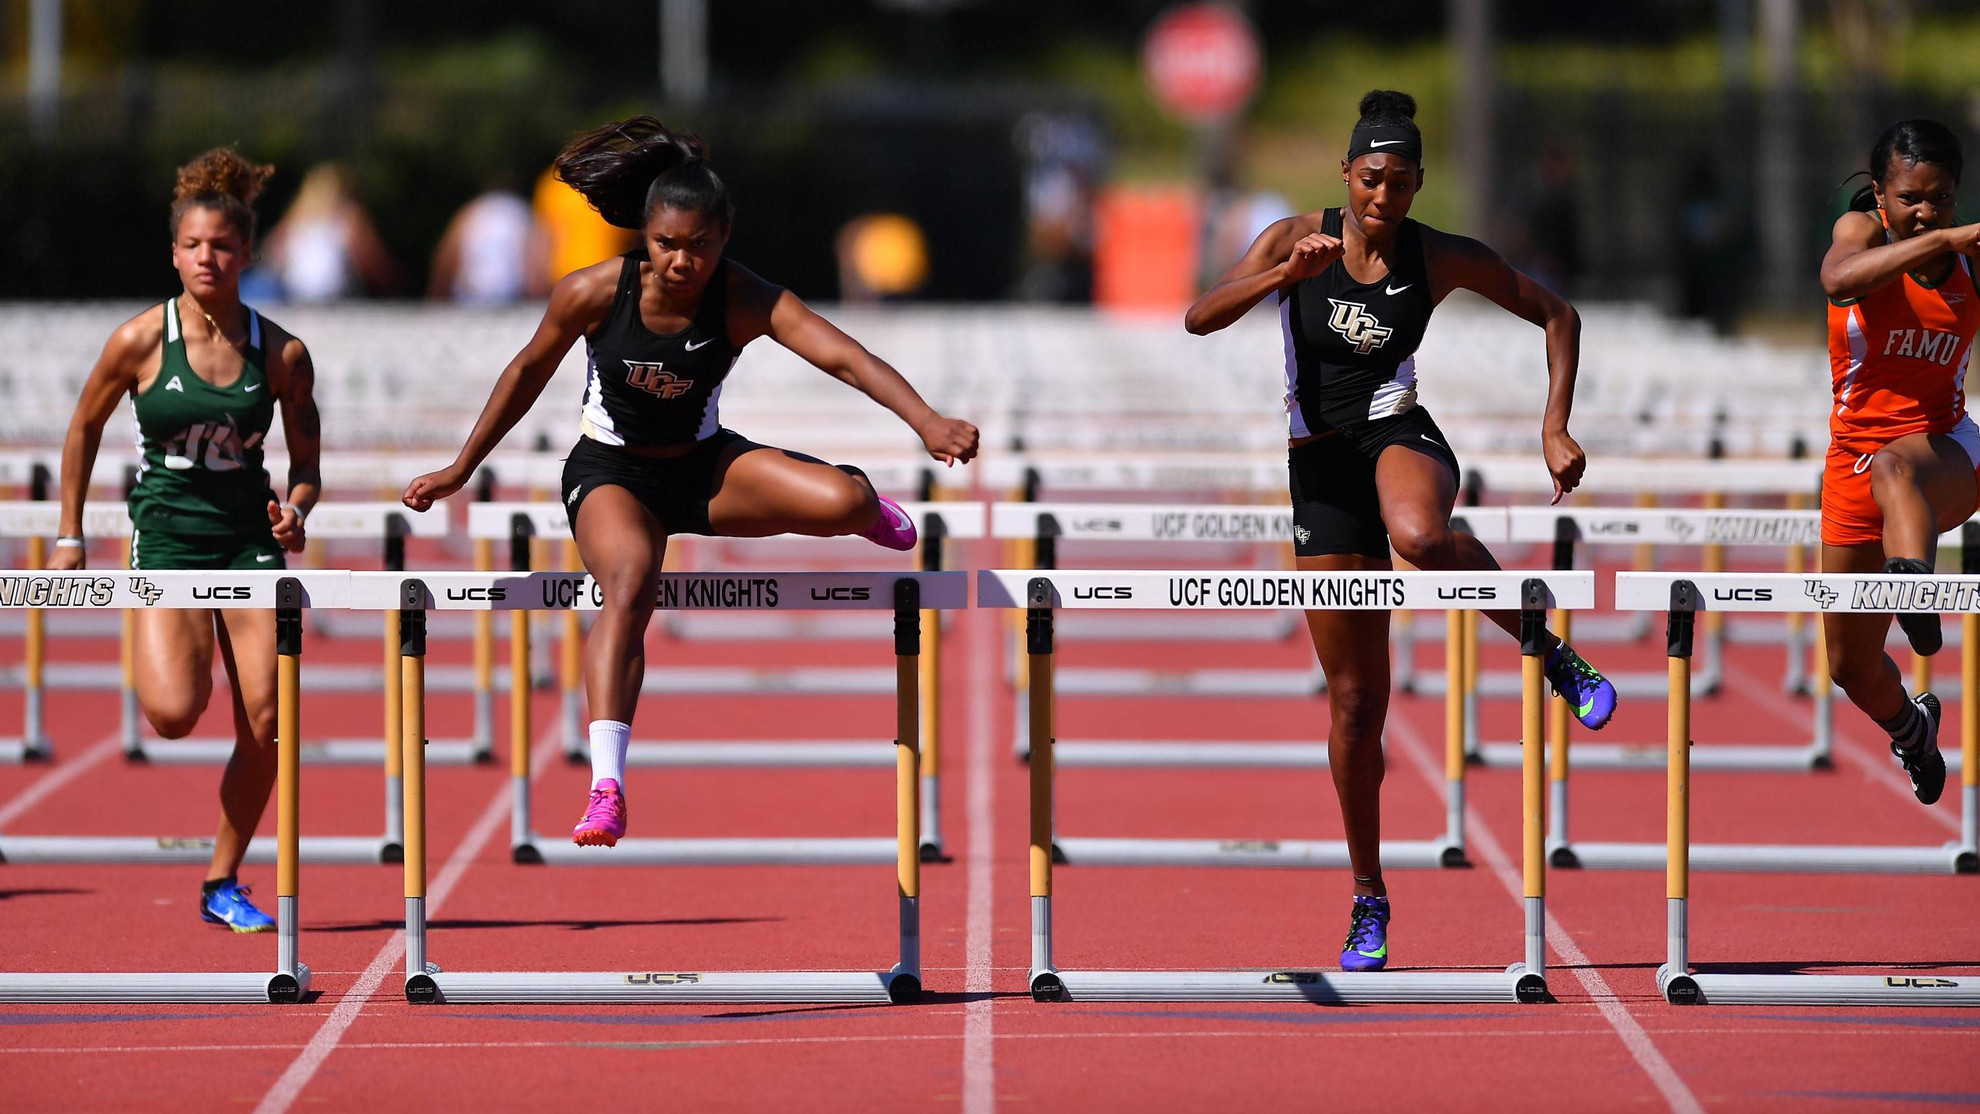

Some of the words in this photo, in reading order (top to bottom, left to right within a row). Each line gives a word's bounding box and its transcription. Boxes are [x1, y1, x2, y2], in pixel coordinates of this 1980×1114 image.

[1327, 298, 1393, 355] UCF
[1883, 329, 1960, 366] FAMU
[622, 360, 693, 399] UCF
[1152, 513, 1187, 538] UCF
[1193, 513, 1266, 538] GOLDEN
[1293, 524, 1311, 545] UCF
[129, 577, 164, 606] UCF
[193, 586, 251, 600] UCS
[447, 587, 506, 601] UCS
[542, 579, 584, 607] UCF
[685, 578, 779, 608] KNIGHTS
[811, 587, 871, 601] UCS
[1074, 586, 1132, 600] UCS
[1169, 578, 1211, 606] UCF
[1217, 578, 1304, 606] GOLDEN
[1312, 578, 1405, 606] KNIGHTS
[1437, 587, 1496, 600] UCS
[1714, 588, 1773, 601] UCS
[1804, 580, 1839, 609] UCF
[1851, 581, 1980, 610] KNIGHT
[1034, 985, 1060, 993] UCS
